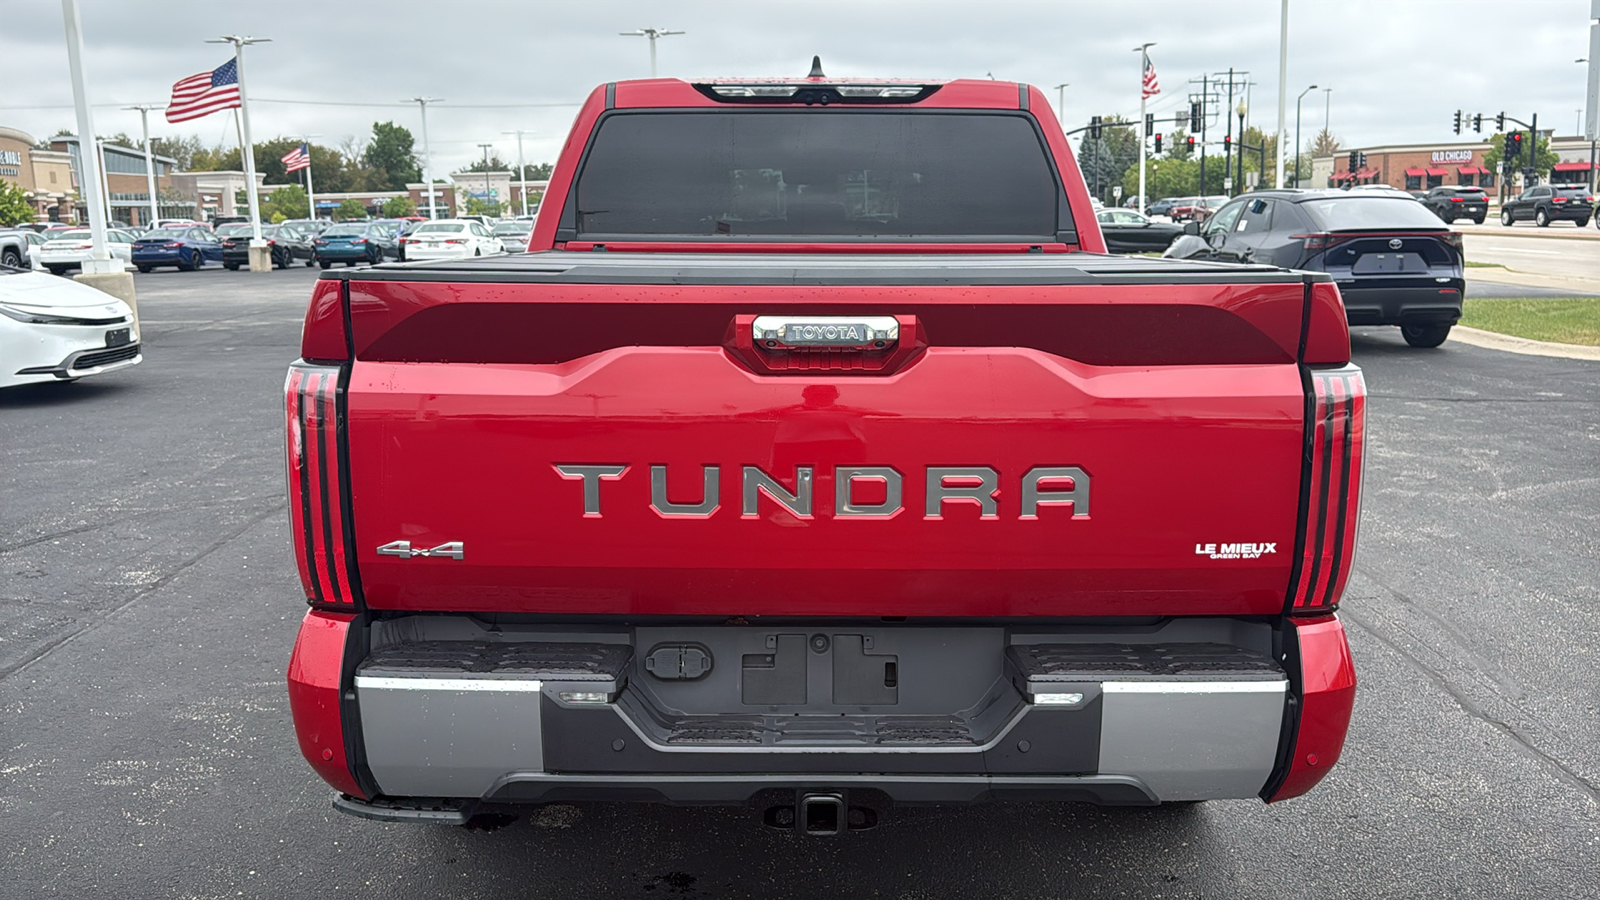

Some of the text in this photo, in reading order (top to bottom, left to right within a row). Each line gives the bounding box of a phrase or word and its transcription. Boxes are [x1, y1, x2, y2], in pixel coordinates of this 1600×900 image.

[1432, 150, 1472, 162] OLD CHICAGO
[792, 326, 859, 339] TOYOTA
[552, 464, 1094, 521] TUNDRA
[1195, 543, 1277, 554] LE MIEUX
